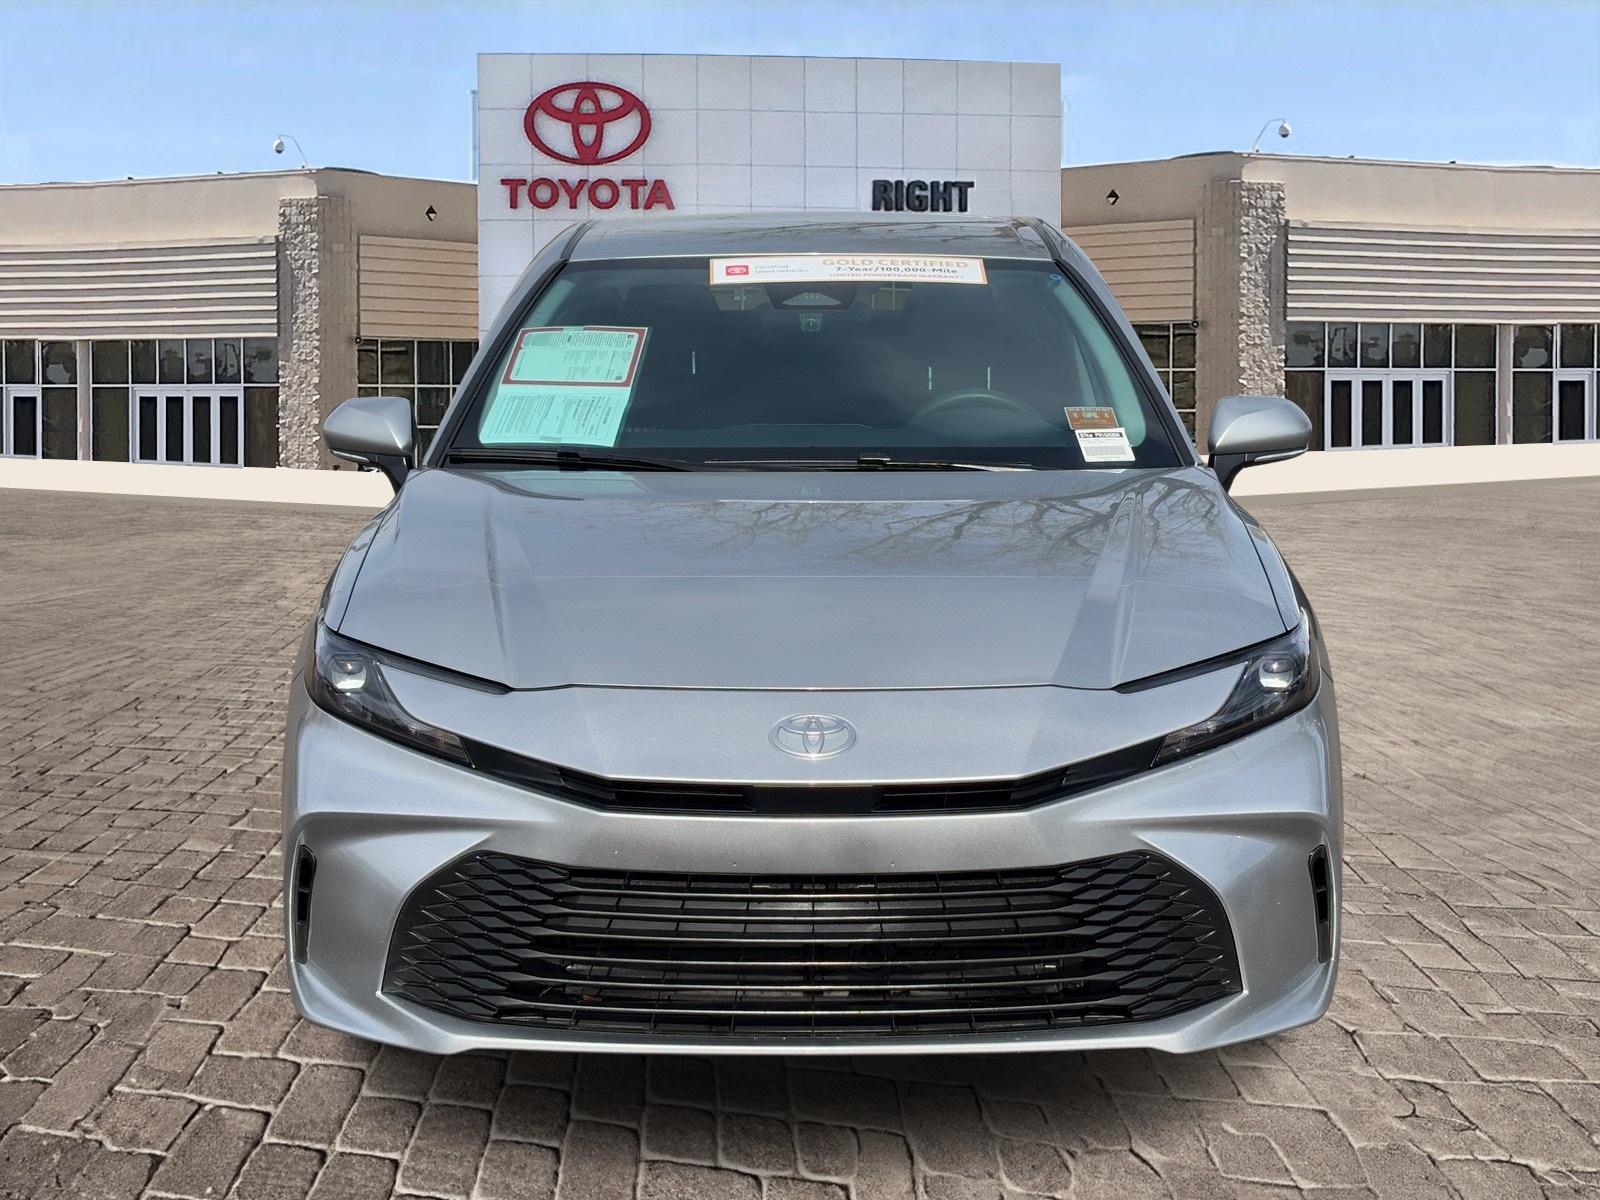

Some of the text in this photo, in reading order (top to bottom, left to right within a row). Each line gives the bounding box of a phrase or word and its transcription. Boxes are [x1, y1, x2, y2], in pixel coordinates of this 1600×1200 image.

[500, 177, 675, 210] TOYOTA
[872, 179, 974, 212] RIGHT
[822, 258, 968, 268] GOLD CERTIFIED
[835, 266, 958, 274] 7-Year/100,000-Mile
